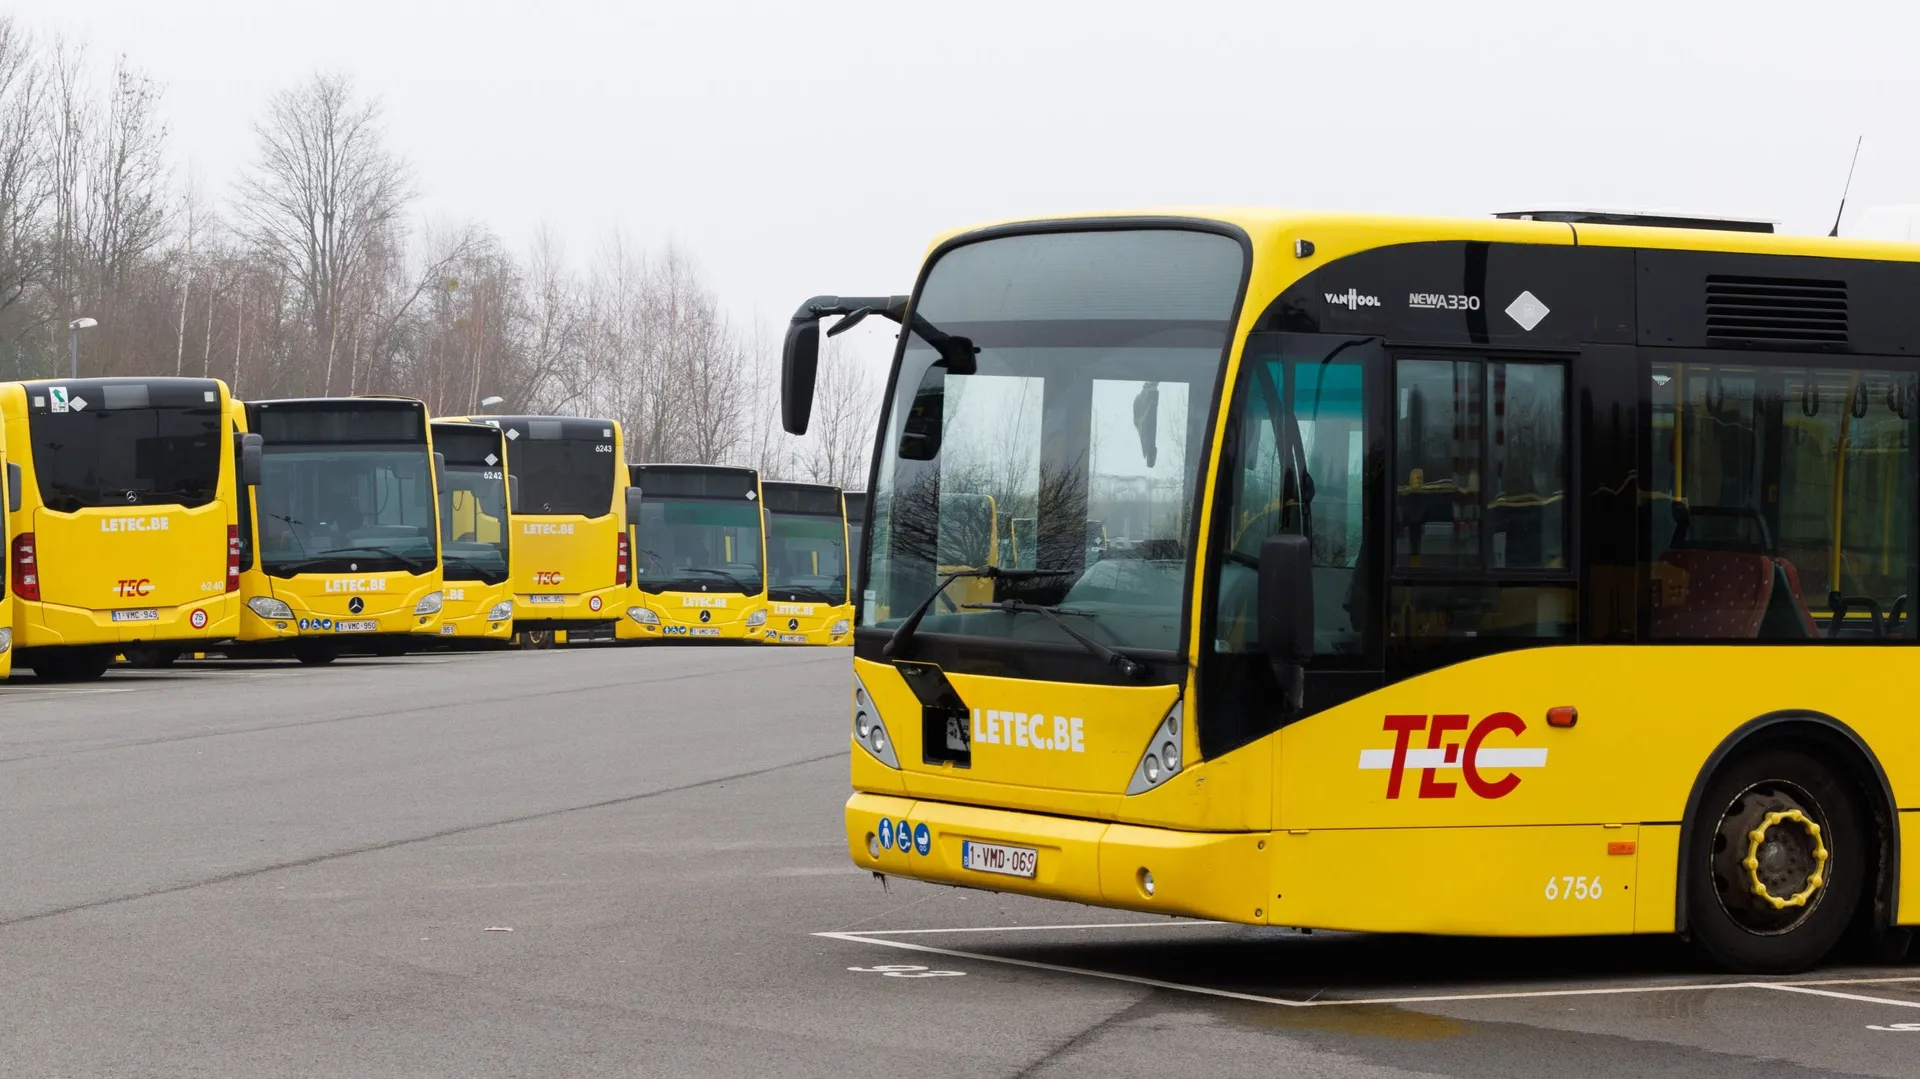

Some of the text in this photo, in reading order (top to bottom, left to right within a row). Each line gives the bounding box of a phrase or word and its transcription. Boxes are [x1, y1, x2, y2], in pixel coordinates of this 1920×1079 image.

[595, 445, 612, 453] 6243
[484, 471, 502, 480] 6242
[101, 516, 169, 532] LETEC.BE
[523, 523, 574, 535] LETEC.BE
[536, 571, 561, 585] TEC
[117, 579, 150, 597] TEC
[201, 580, 224, 591] 6240
[325, 578, 386, 592] LETEC.BE
[683, 597, 726, 608] LETEC.BE
[774, 605, 813, 615] LETEC.BE
[194, 613, 203, 621] 75
[973, 708, 1085, 752] LETEC.BE
[1382, 711, 1528, 800] TEC
[1544, 876, 1603, 900] 6756
